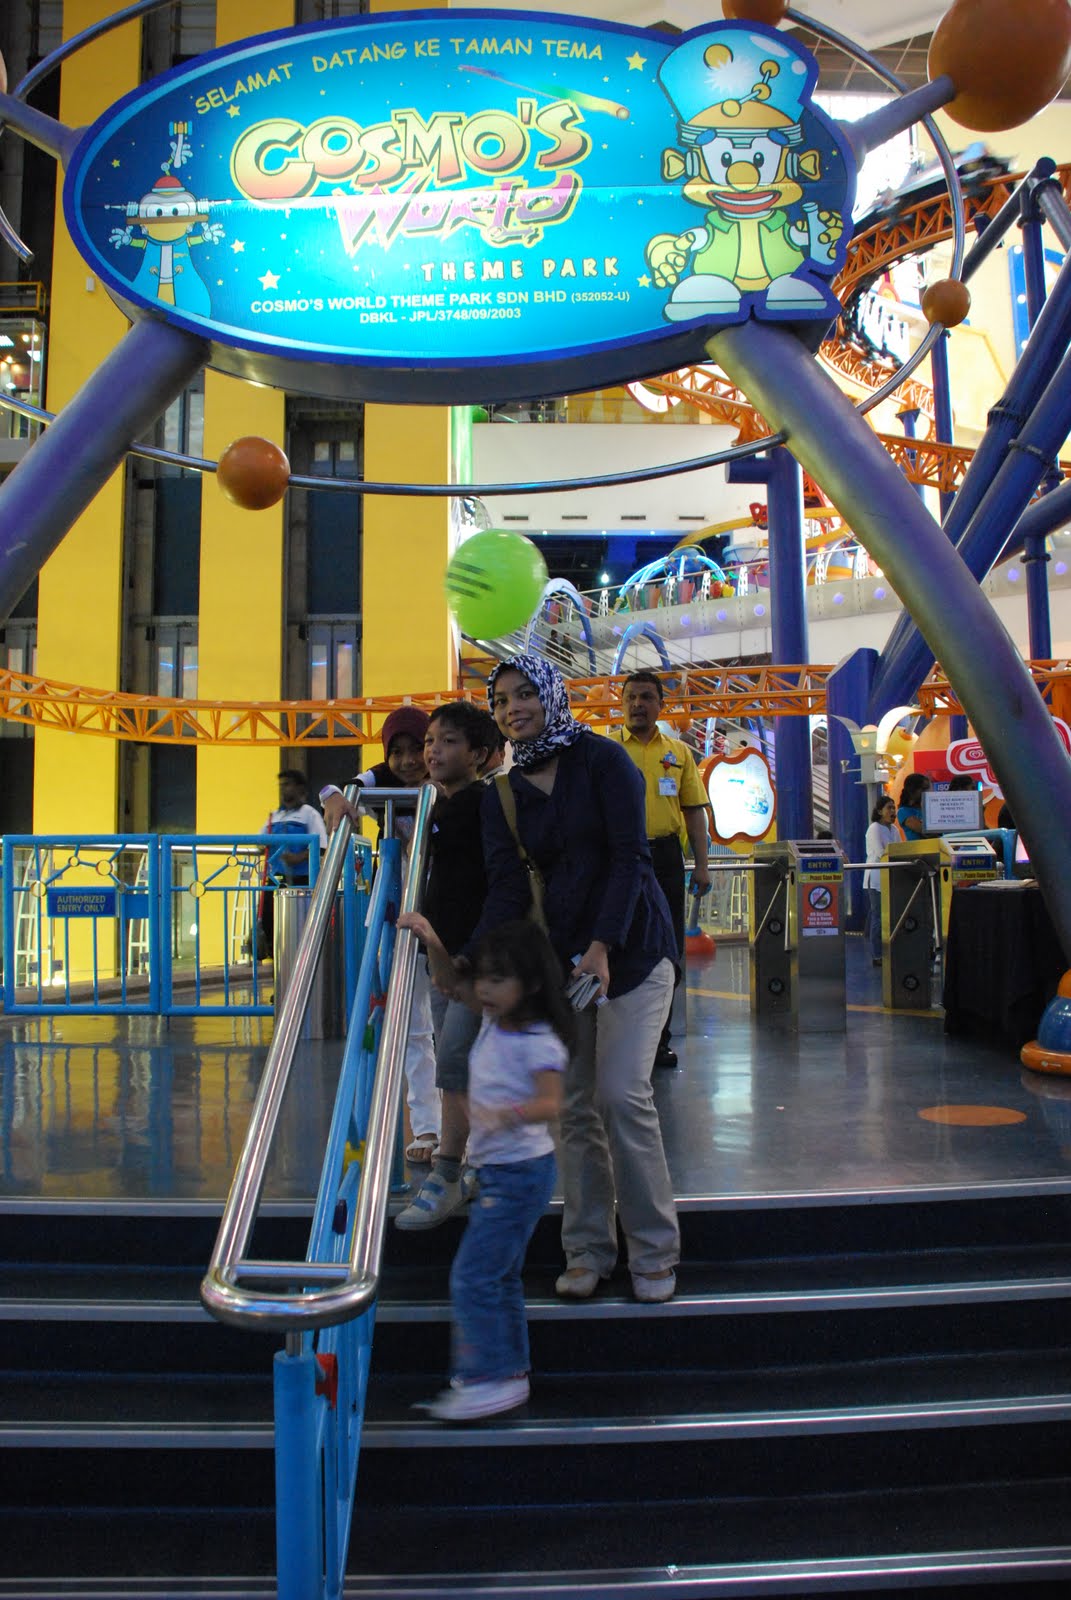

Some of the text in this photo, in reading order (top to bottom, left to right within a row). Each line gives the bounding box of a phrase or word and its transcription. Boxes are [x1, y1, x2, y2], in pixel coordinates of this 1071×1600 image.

[195, 37, 603, 114] SELAMAT DATANG KE TAMAN TEMA
[230, 98, 592, 203] COSMO'S
[421, 257, 619, 282] THEME PARK
[250, 290, 631, 314] COSMO'S WORLD THEME PARK SDN BHD (352052-U)
[360, 312, 398, 324] DBKL
[409, 308, 521, 322] JPL/3748/09/2003
[962, 859, 986, 867] ENTRY
[57, 895, 106, 904] AUTHORIZED
[57, 904, 105, 912] ENTRY ONLY
